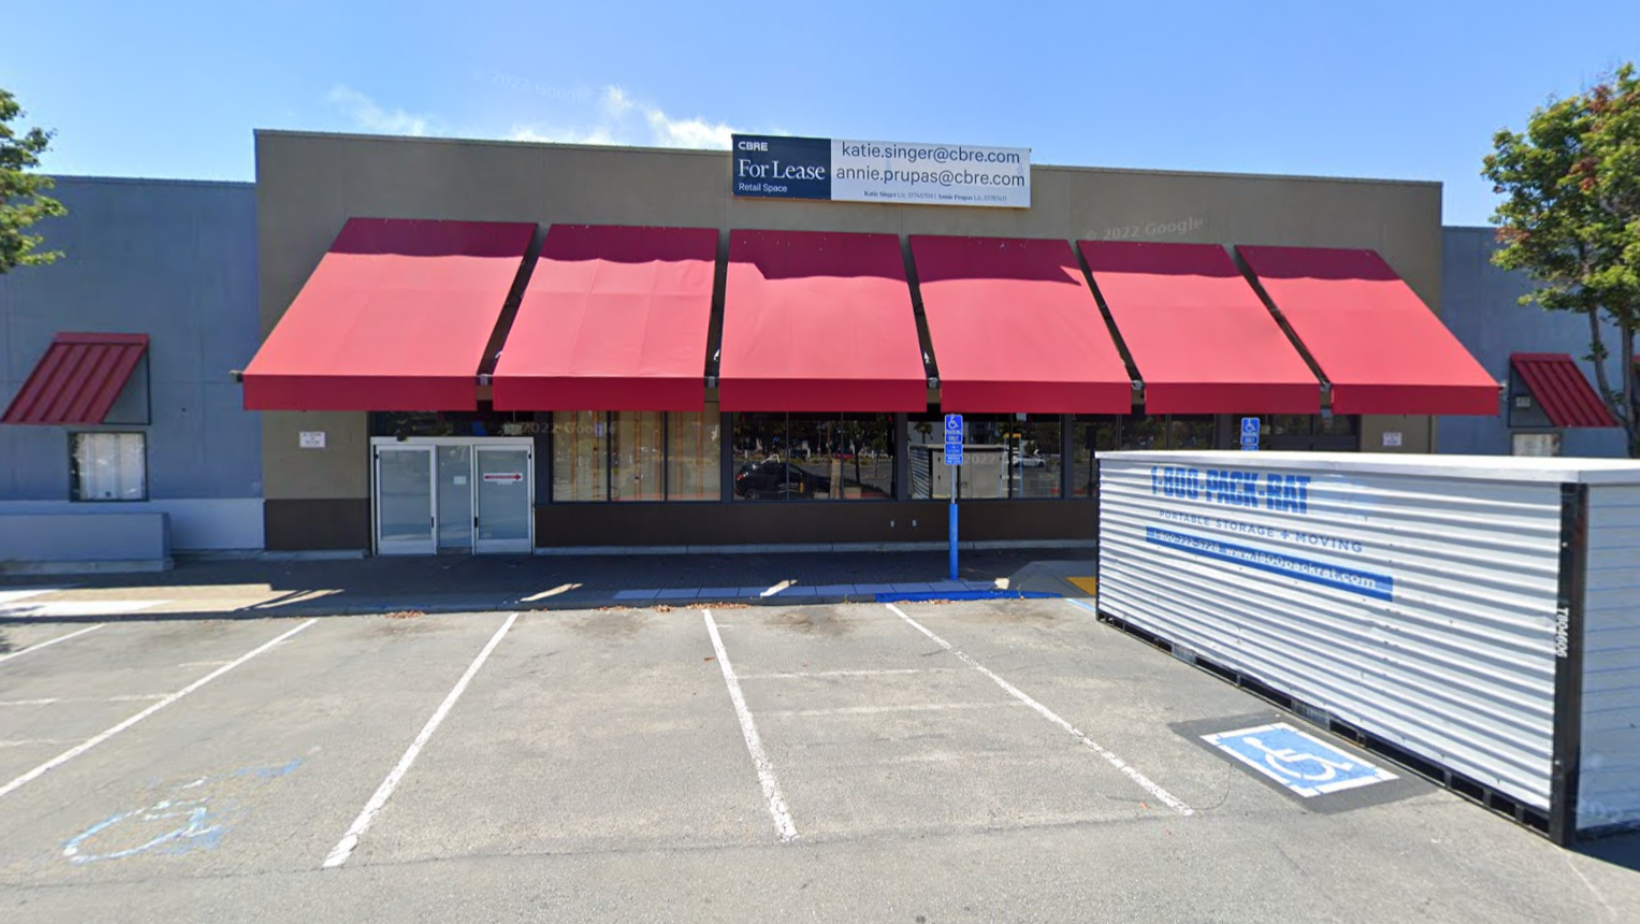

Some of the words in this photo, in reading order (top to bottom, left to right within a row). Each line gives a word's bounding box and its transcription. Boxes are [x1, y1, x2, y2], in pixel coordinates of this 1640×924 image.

[738, 141, 768, 151] CBRE
[842, 142, 1020, 164] katie.singer@cbre.com
[738, 158, 769, 178] For
[772, 160, 825, 180] Lease
[836, 165, 1025, 187] annie.prupas@cbre.com
[739, 182, 761, 191] Retail
[763, 183, 787, 193] Space
[1158, 509, 1211, 527] PORTABLE
[1215, 517, 1275, 538] STORAGE
[1295, 531, 1364, 554] MOVING
